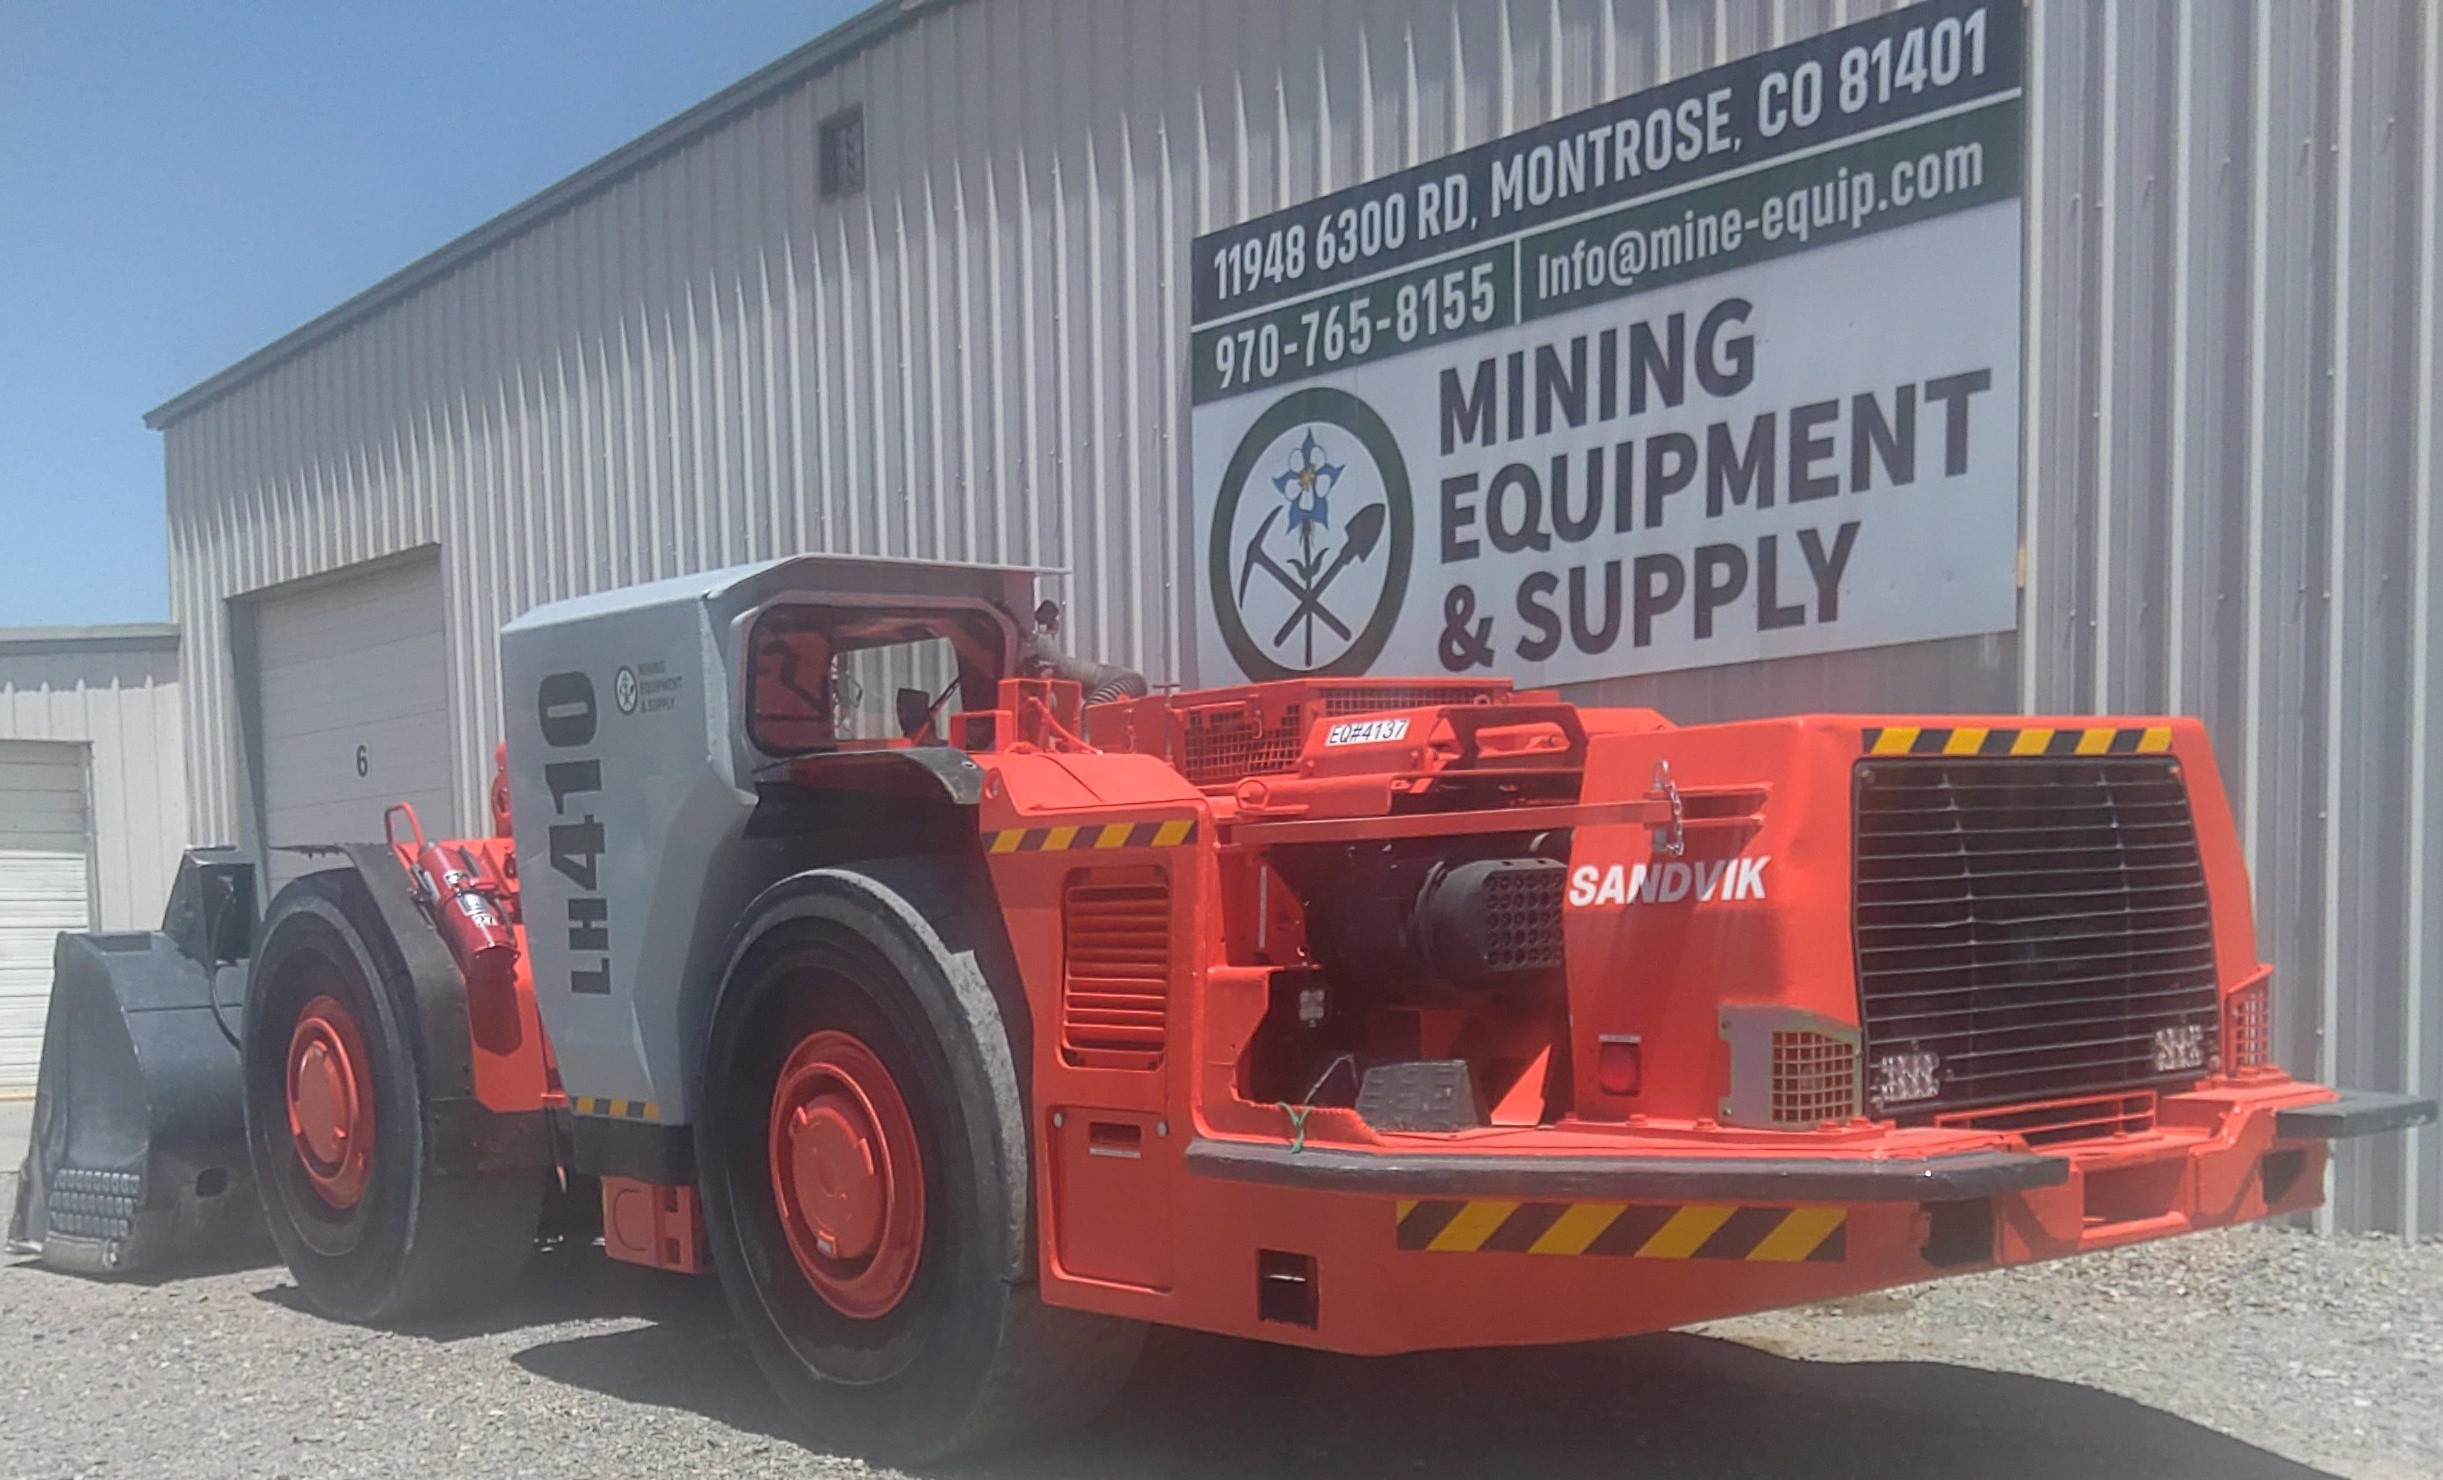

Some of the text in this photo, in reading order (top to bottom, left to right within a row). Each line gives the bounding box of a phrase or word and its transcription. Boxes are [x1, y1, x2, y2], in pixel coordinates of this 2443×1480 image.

[1214, 8, 1987, 299] 11948 6300 RD, MONTROSE, CO 81401
[1539, 142, 1983, 300] Info@mine-equip.com
[1216, 262, 1495, 389] 970-765-8155
[1440, 298, 1754, 455] MINING
[1440, 369, 1992, 563] EQUIPMENT
[1438, 521, 1861, 672] & SUPPLY
[356, 744, 368, 777] 6
[1329, 719, 1408, 744] EQ#4137
[538, 671, 611, 995] LH410
[1569, 856, 1771, 907] SANDVIK
